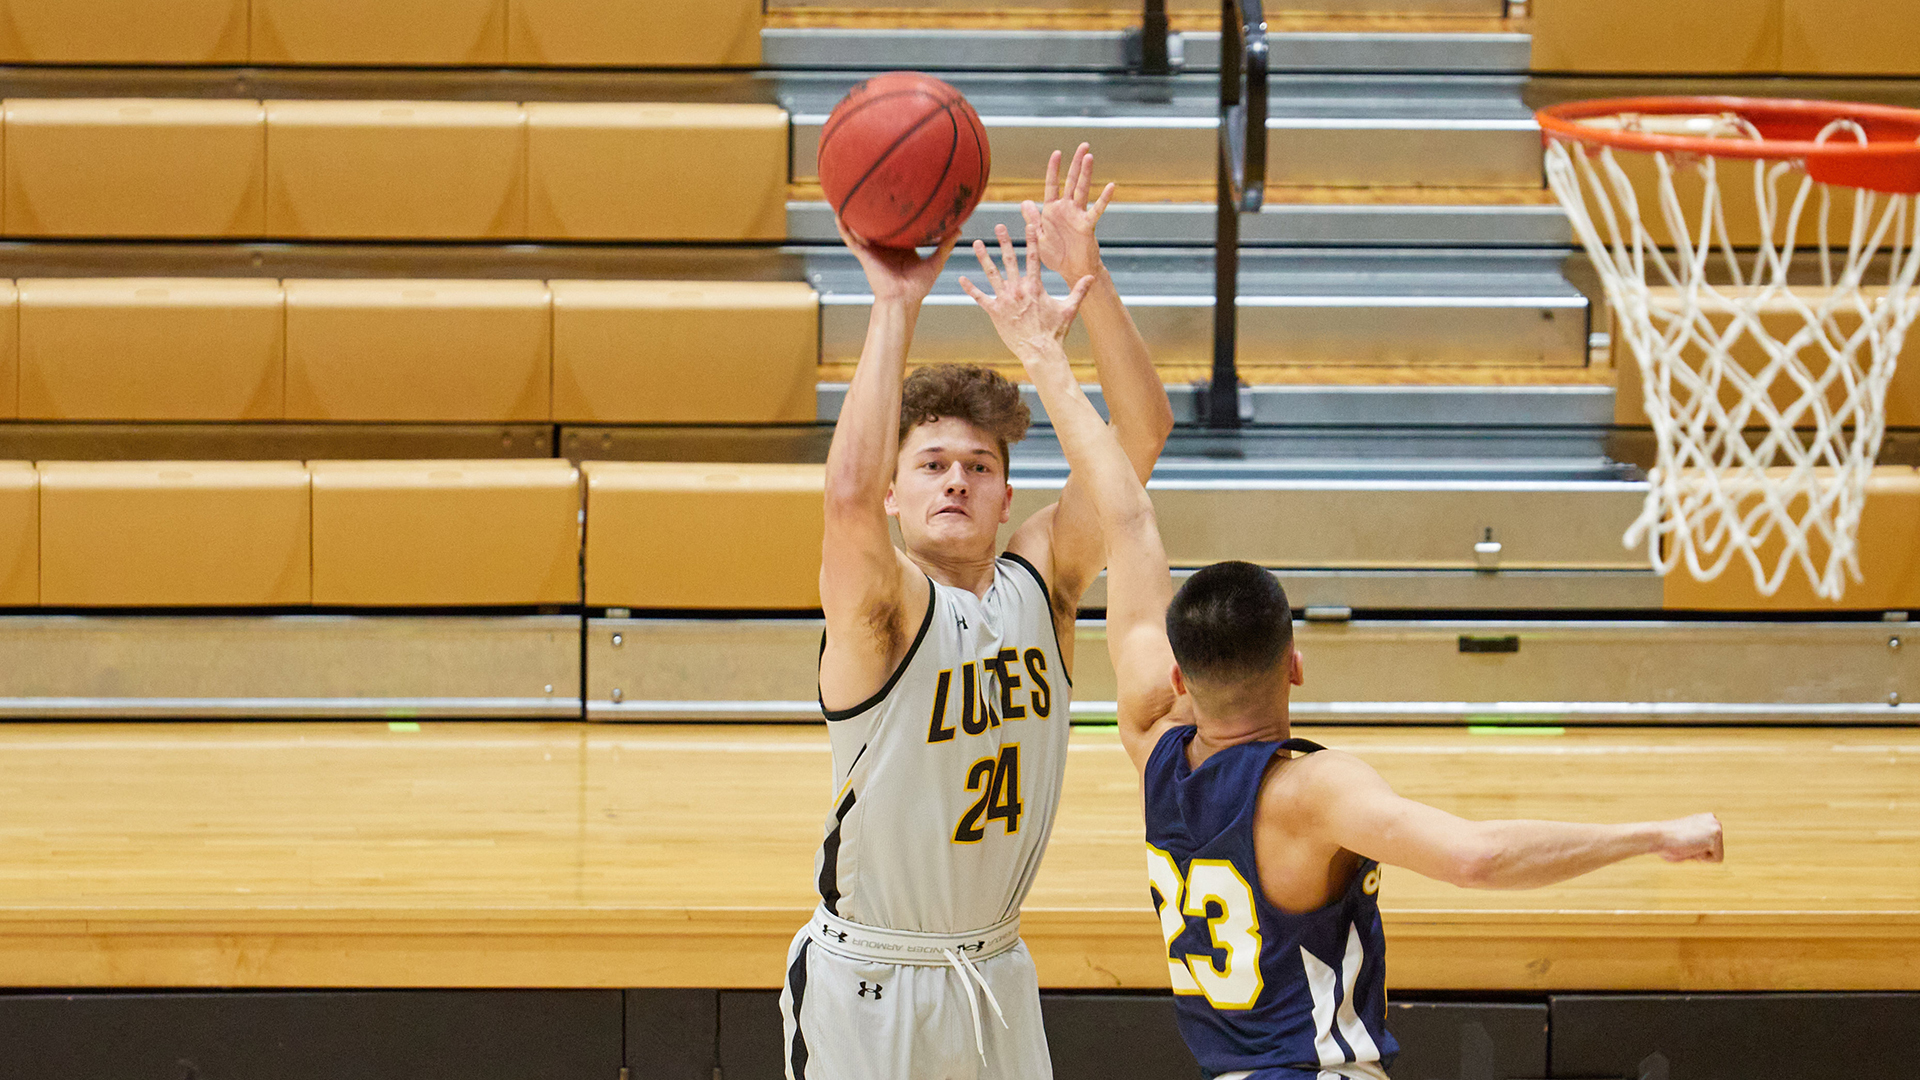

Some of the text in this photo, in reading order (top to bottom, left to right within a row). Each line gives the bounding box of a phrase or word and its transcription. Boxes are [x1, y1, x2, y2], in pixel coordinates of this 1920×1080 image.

[951, 742, 1024, 844] 24
[852, 938, 904, 951] ARMOUR
[1146, 841, 1264, 1010] 23
